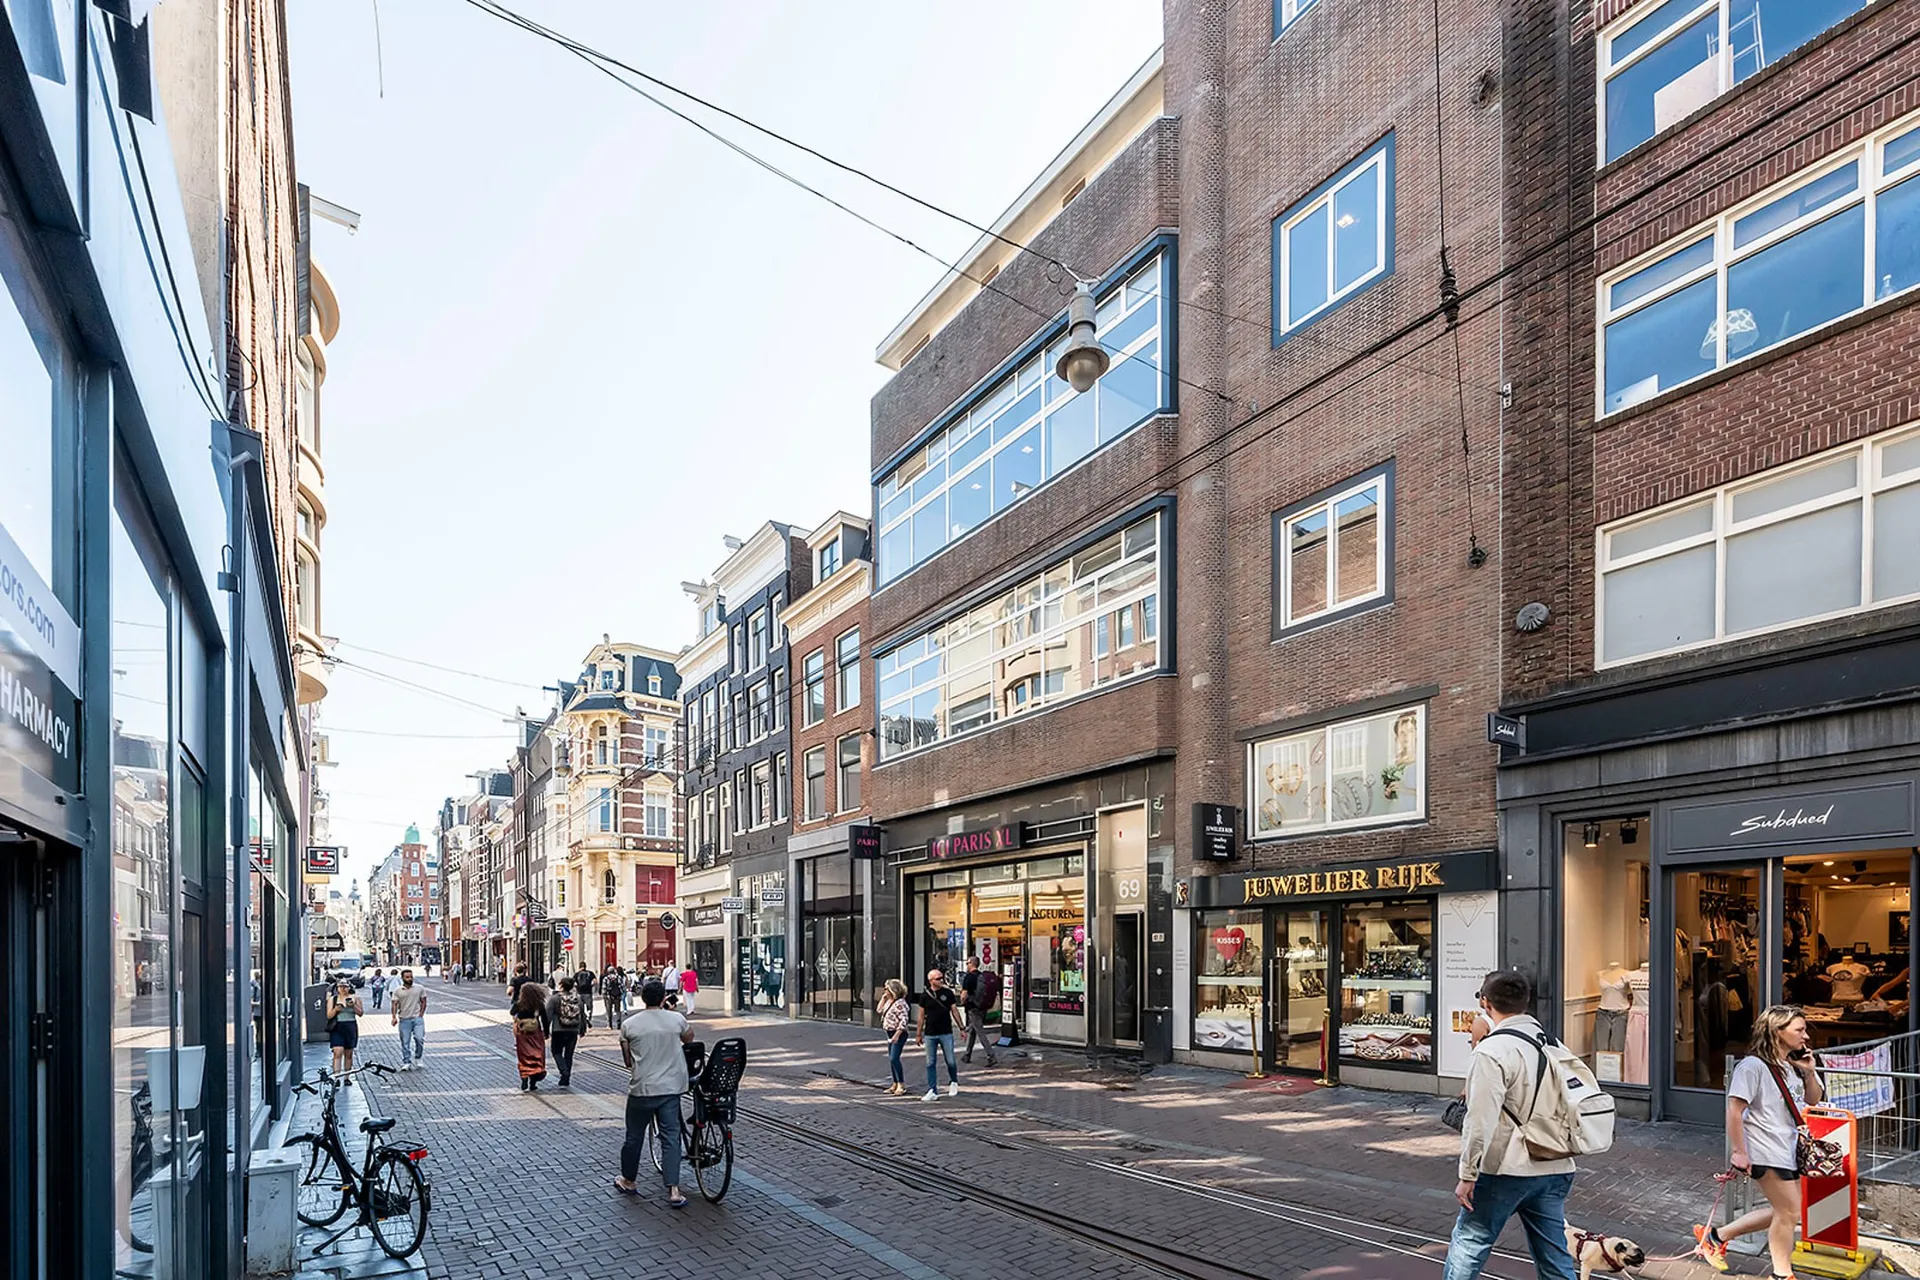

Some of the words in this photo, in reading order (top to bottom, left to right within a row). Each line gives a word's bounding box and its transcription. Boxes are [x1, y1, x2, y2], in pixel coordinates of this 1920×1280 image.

[0, 558, 55, 650] ors.com
[1, 665, 70, 759] HARMACY
[1730, 805, 1835, 836] Subdued
[931, 839, 949, 859] ICI
[953, 831, 992, 854] PARIS
[995, 827, 1013, 849] XL
[1119, 879, 1141, 899] 69
[1243, 870, 1372, 903] JUWELIER
[1376, 862, 1445, 893] RIJK
[1008, 909, 1075, 920] HENGEUREN
[1216, 937, 1241, 945] KISSES
